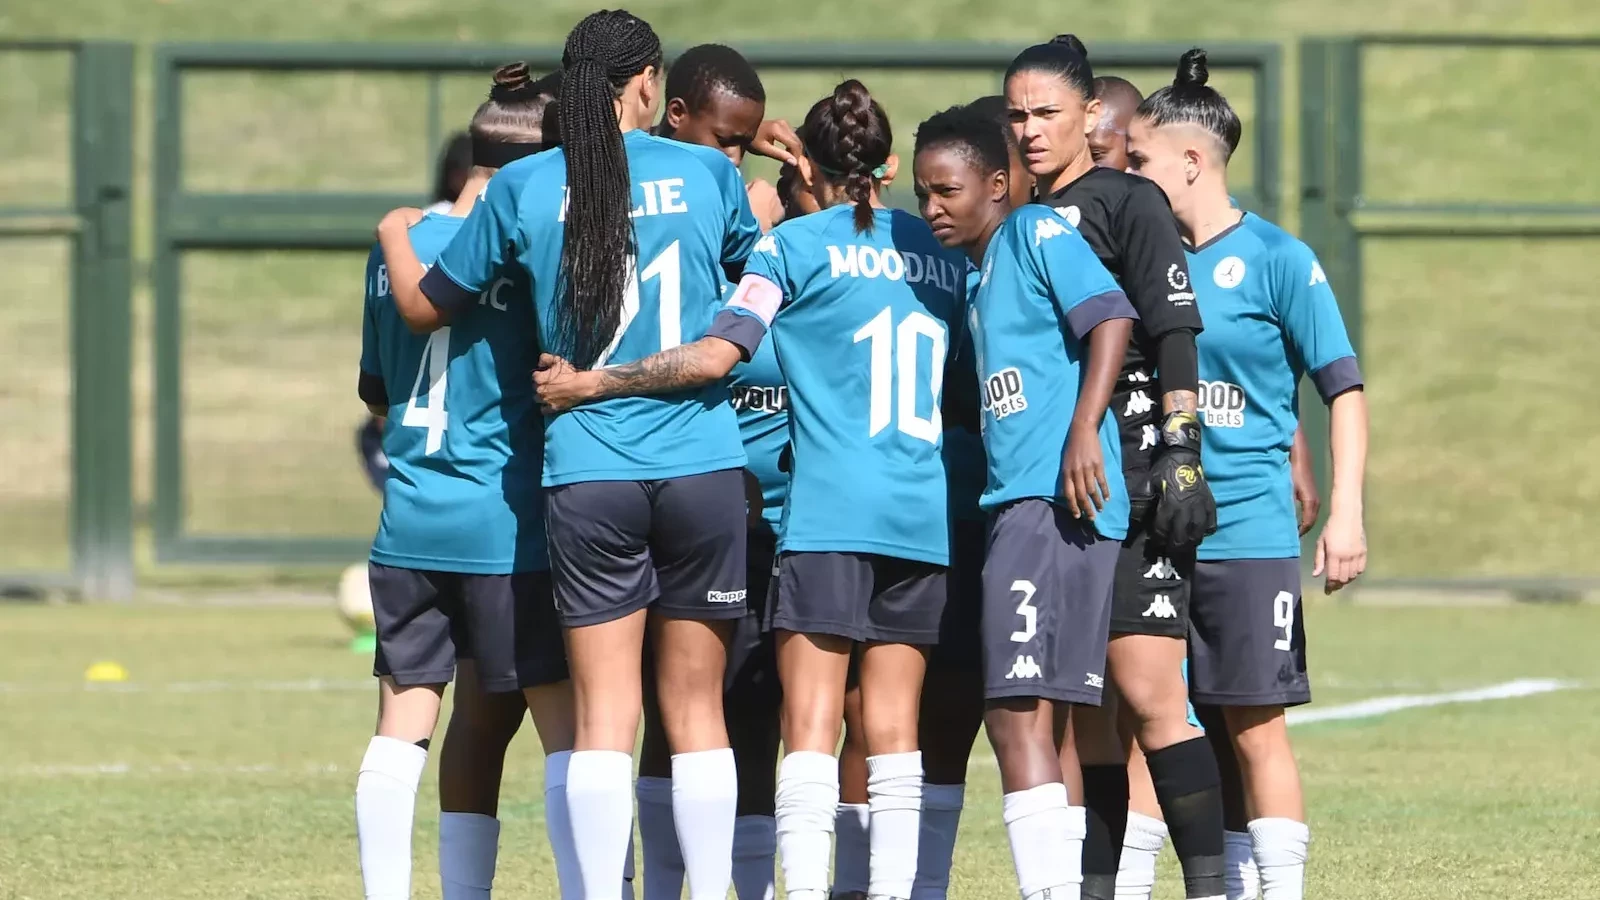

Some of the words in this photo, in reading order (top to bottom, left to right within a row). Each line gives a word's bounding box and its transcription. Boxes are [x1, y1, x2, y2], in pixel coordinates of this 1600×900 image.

[826, 245, 960, 298] MOODALY
[401, 325, 451, 456] 4
[853, 306, 948, 444] 10
[993, 397, 1024, 418] bets
[1207, 410, 1241, 425] bets
[1010, 579, 1037, 643] 3
[1273, 590, 1294, 651] 9
